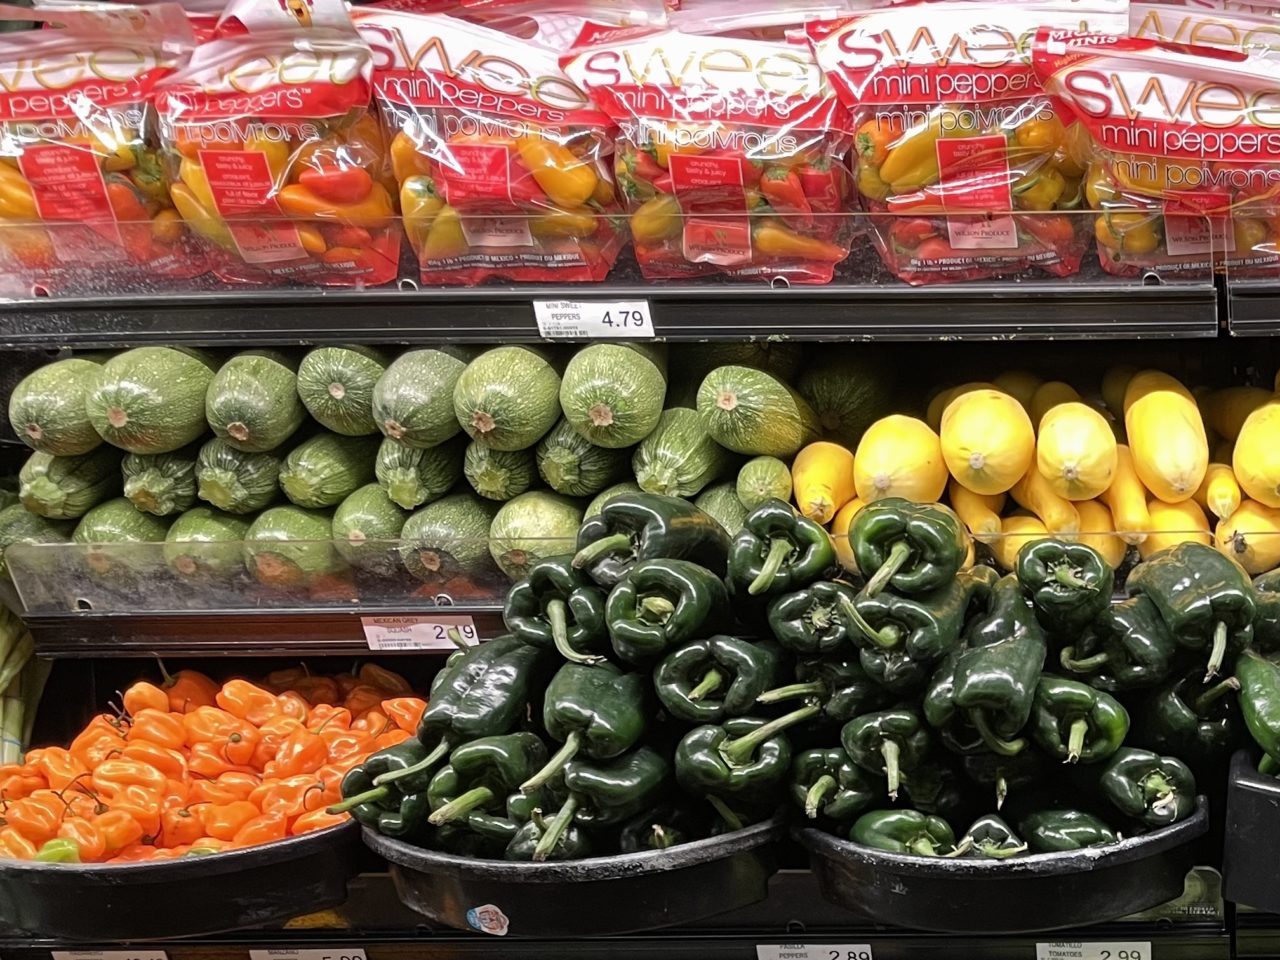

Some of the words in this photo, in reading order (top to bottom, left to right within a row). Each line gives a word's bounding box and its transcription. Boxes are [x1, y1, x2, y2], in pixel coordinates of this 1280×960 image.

[873, 71, 930, 95] mini
[384, 71, 435, 98] mini
[441, 78, 565, 122] peppers
[613, 90, 664, 110] mini
[876, 105, 930, 131] mini
[939, 101, 1054, 136] poivrons
[675, 127, 797, 152] poivrons
[1102, 123, 1157, 147] mini
[1112, 154, 1157, 181] mini
[602, 311, 644, 327] 4.79
